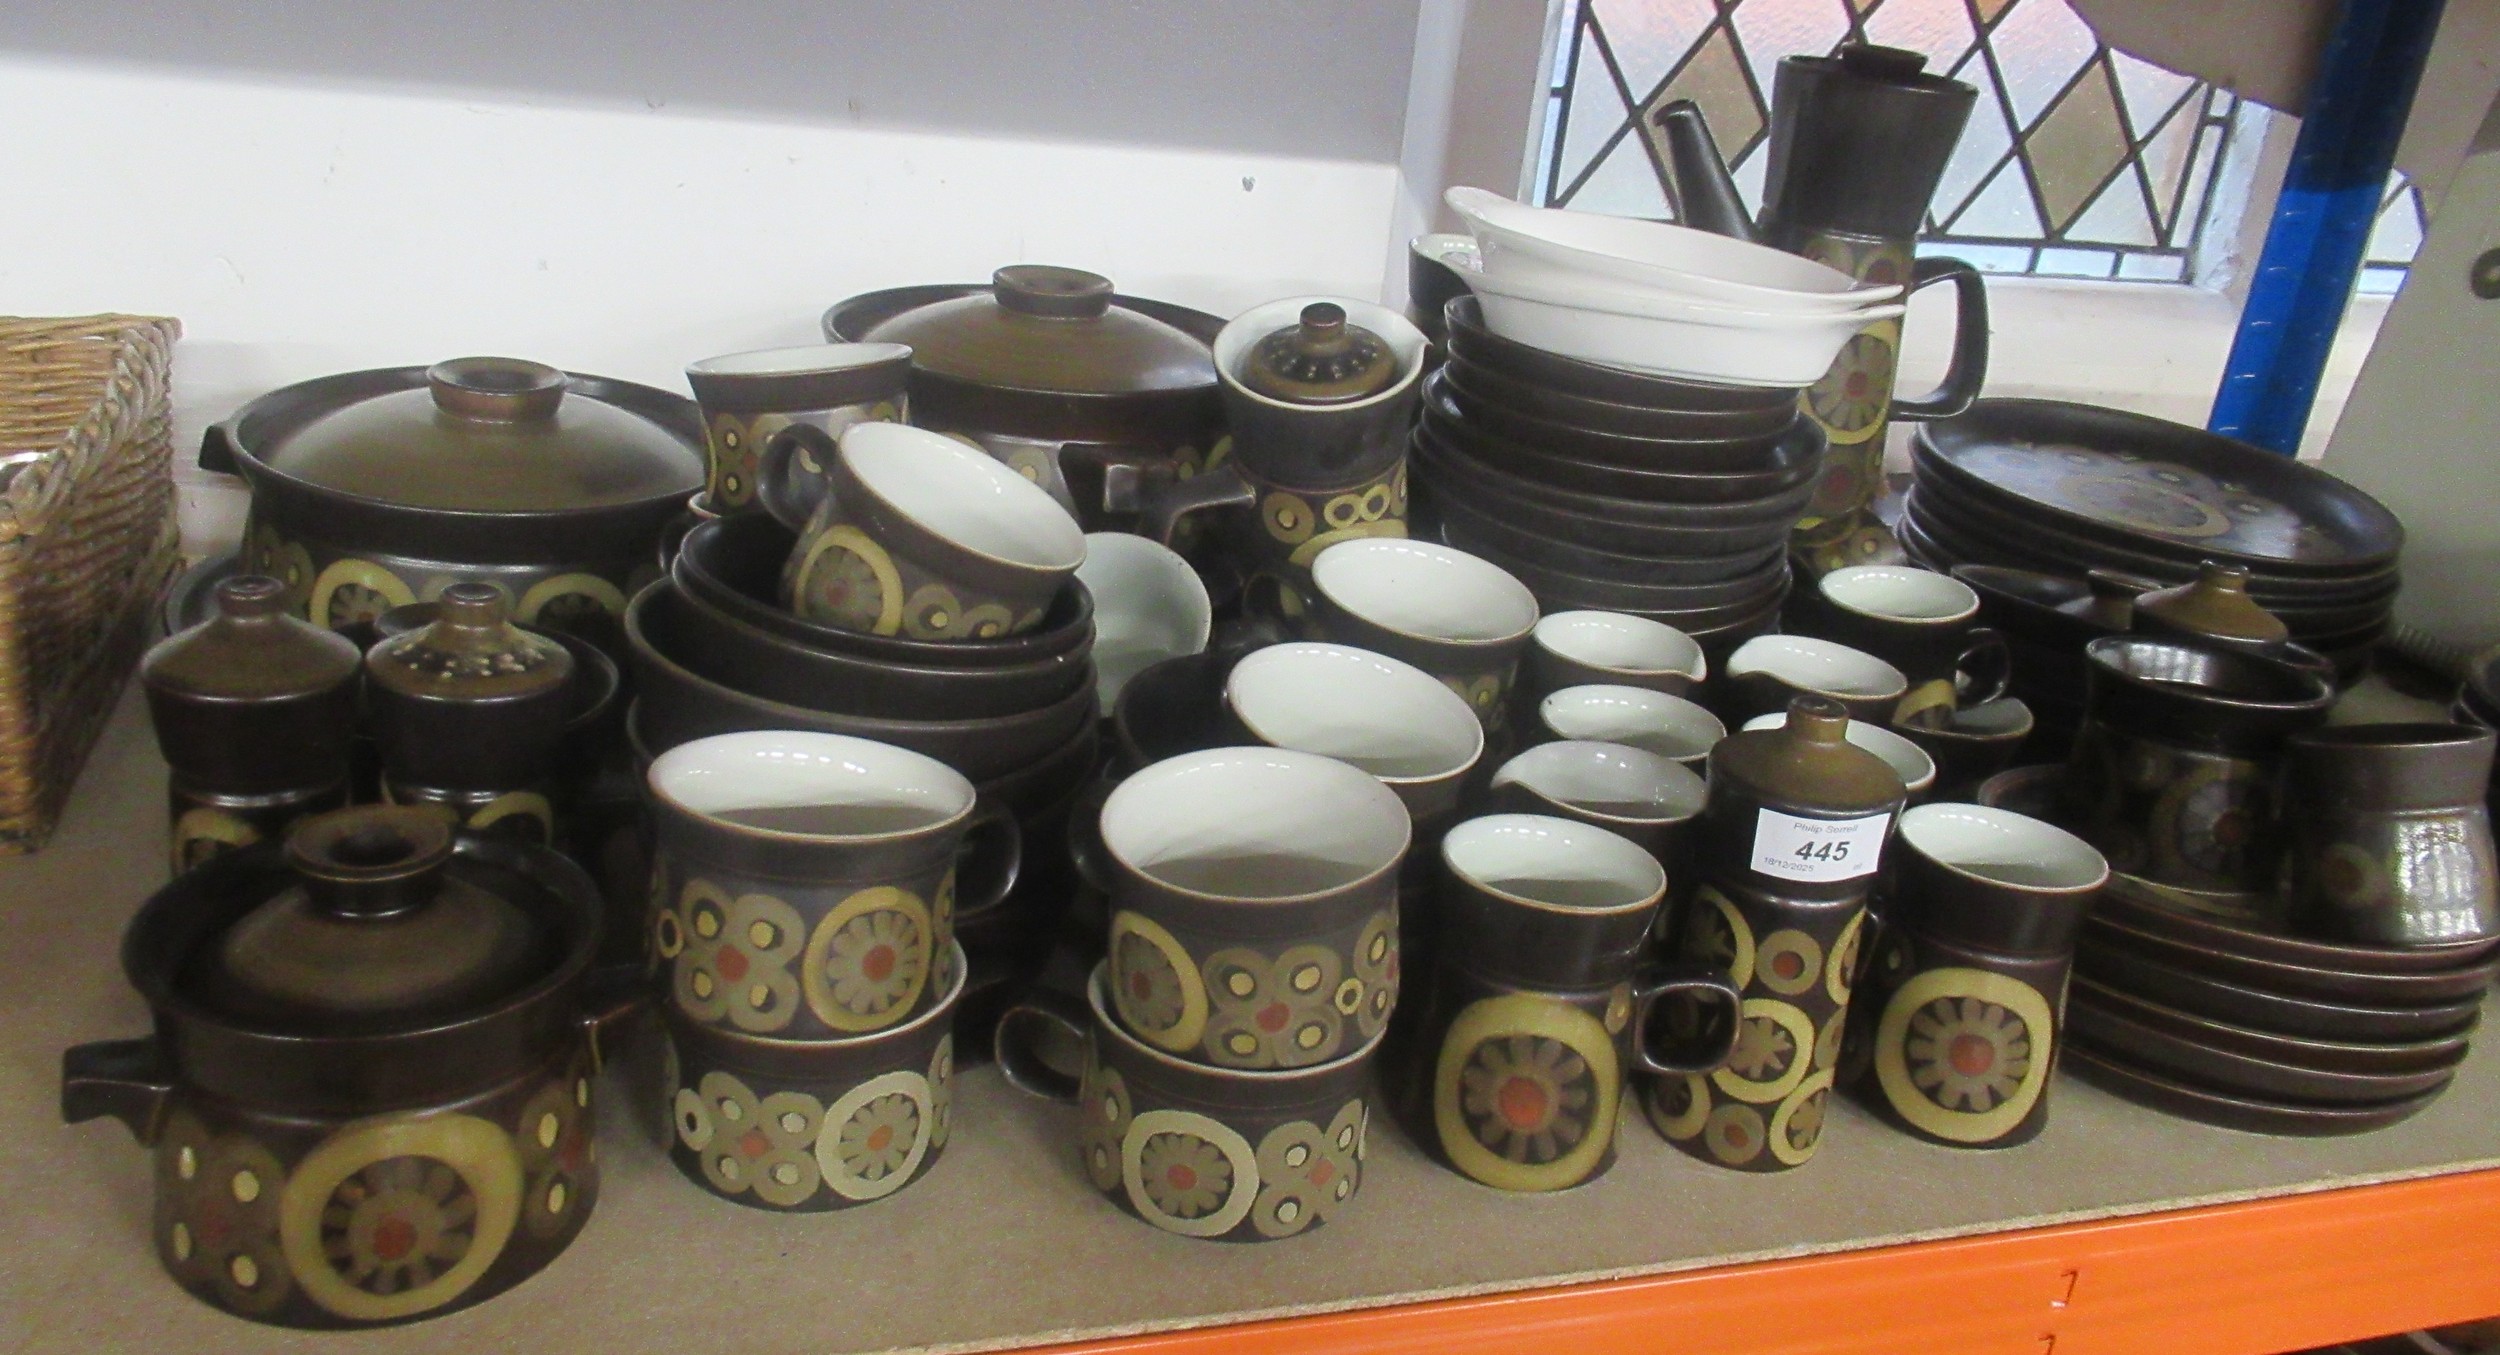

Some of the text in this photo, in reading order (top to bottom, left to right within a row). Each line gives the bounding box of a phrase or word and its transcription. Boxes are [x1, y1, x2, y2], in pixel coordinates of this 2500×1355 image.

[1793, 822, 1823, 834] Philip
[1795, 841, 1850, 861] 445
[1763, 857, 1814, 872] 18/12/2025
